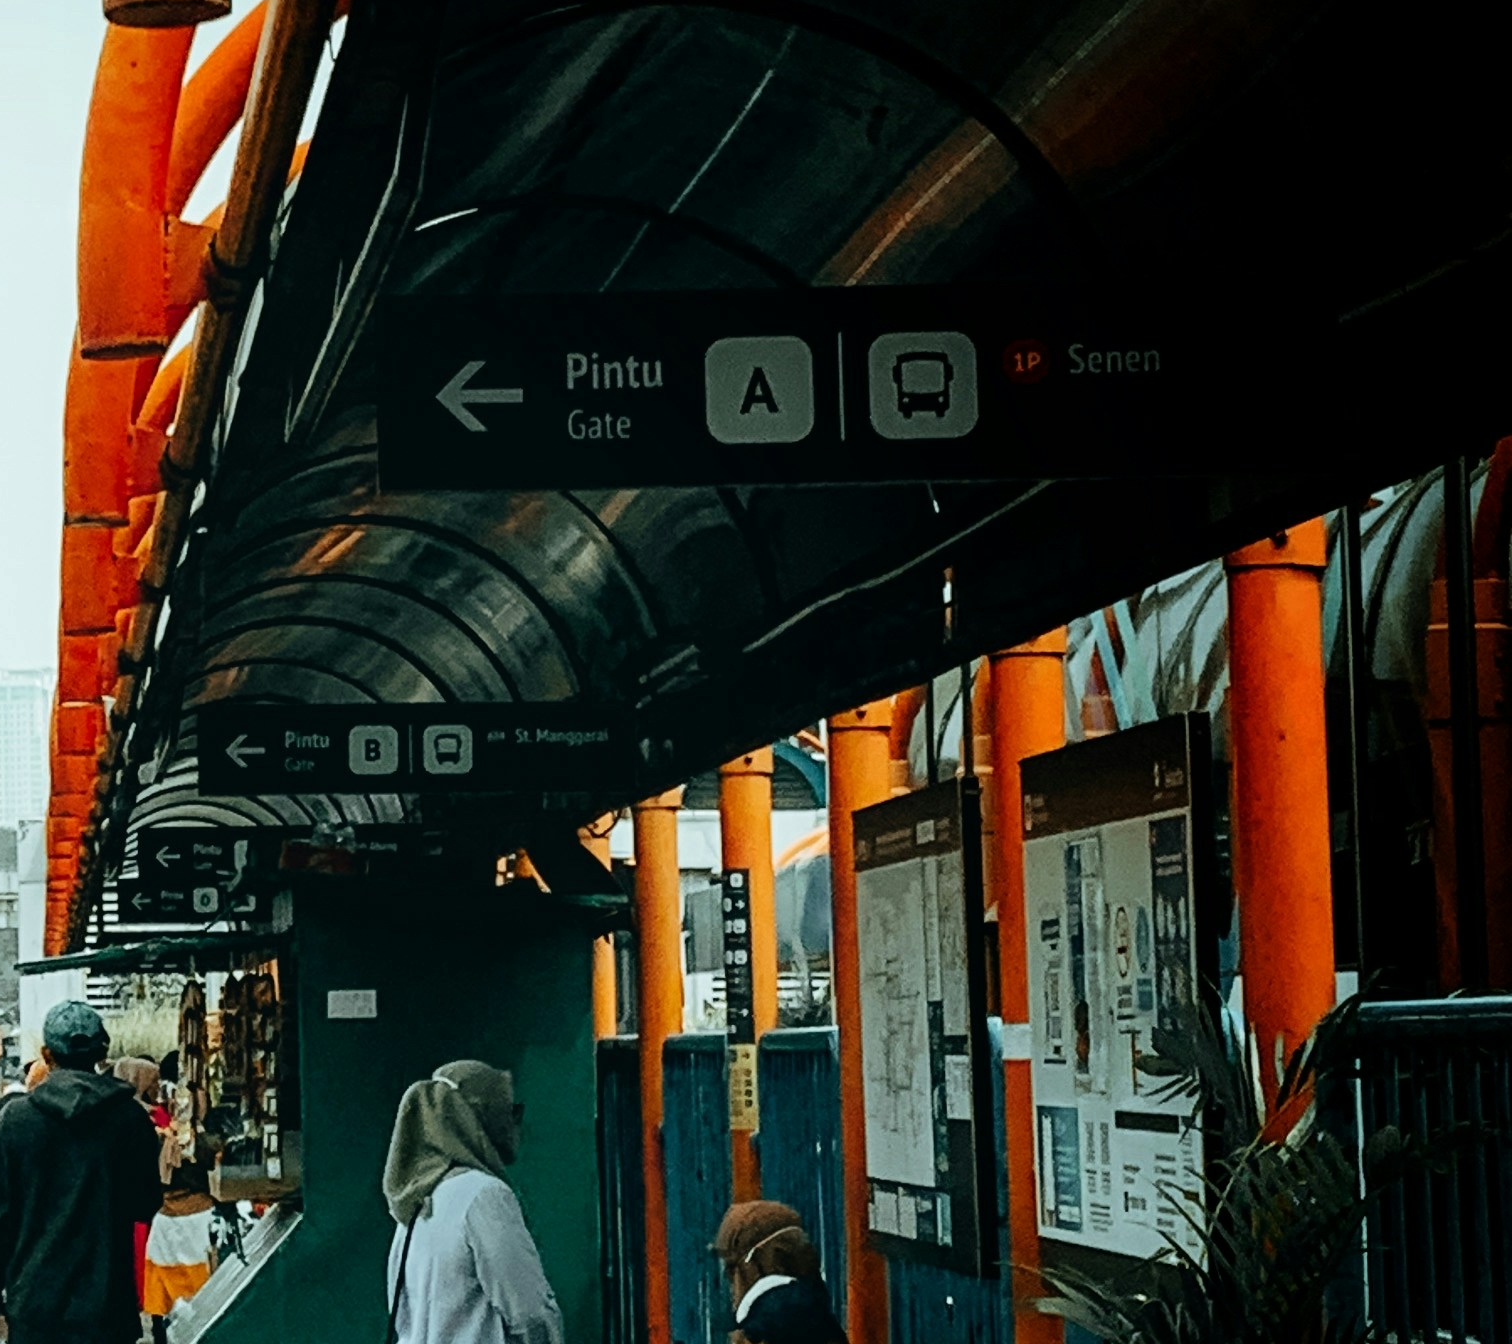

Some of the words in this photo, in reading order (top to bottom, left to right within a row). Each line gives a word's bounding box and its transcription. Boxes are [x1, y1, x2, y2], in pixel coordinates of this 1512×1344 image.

[565, 351, 665, 391] Pintu
[1013, 349, 1043, 373] 1P
[1068, 343, 1162, 377] Senen
[738, 366, 780, 416] A
[567, 408, 632, 441] Gate
[284, 730, 331, 750] Pintu
[364, 738, 381, 762] B
[535, 727, 609, 747] Manggarai
